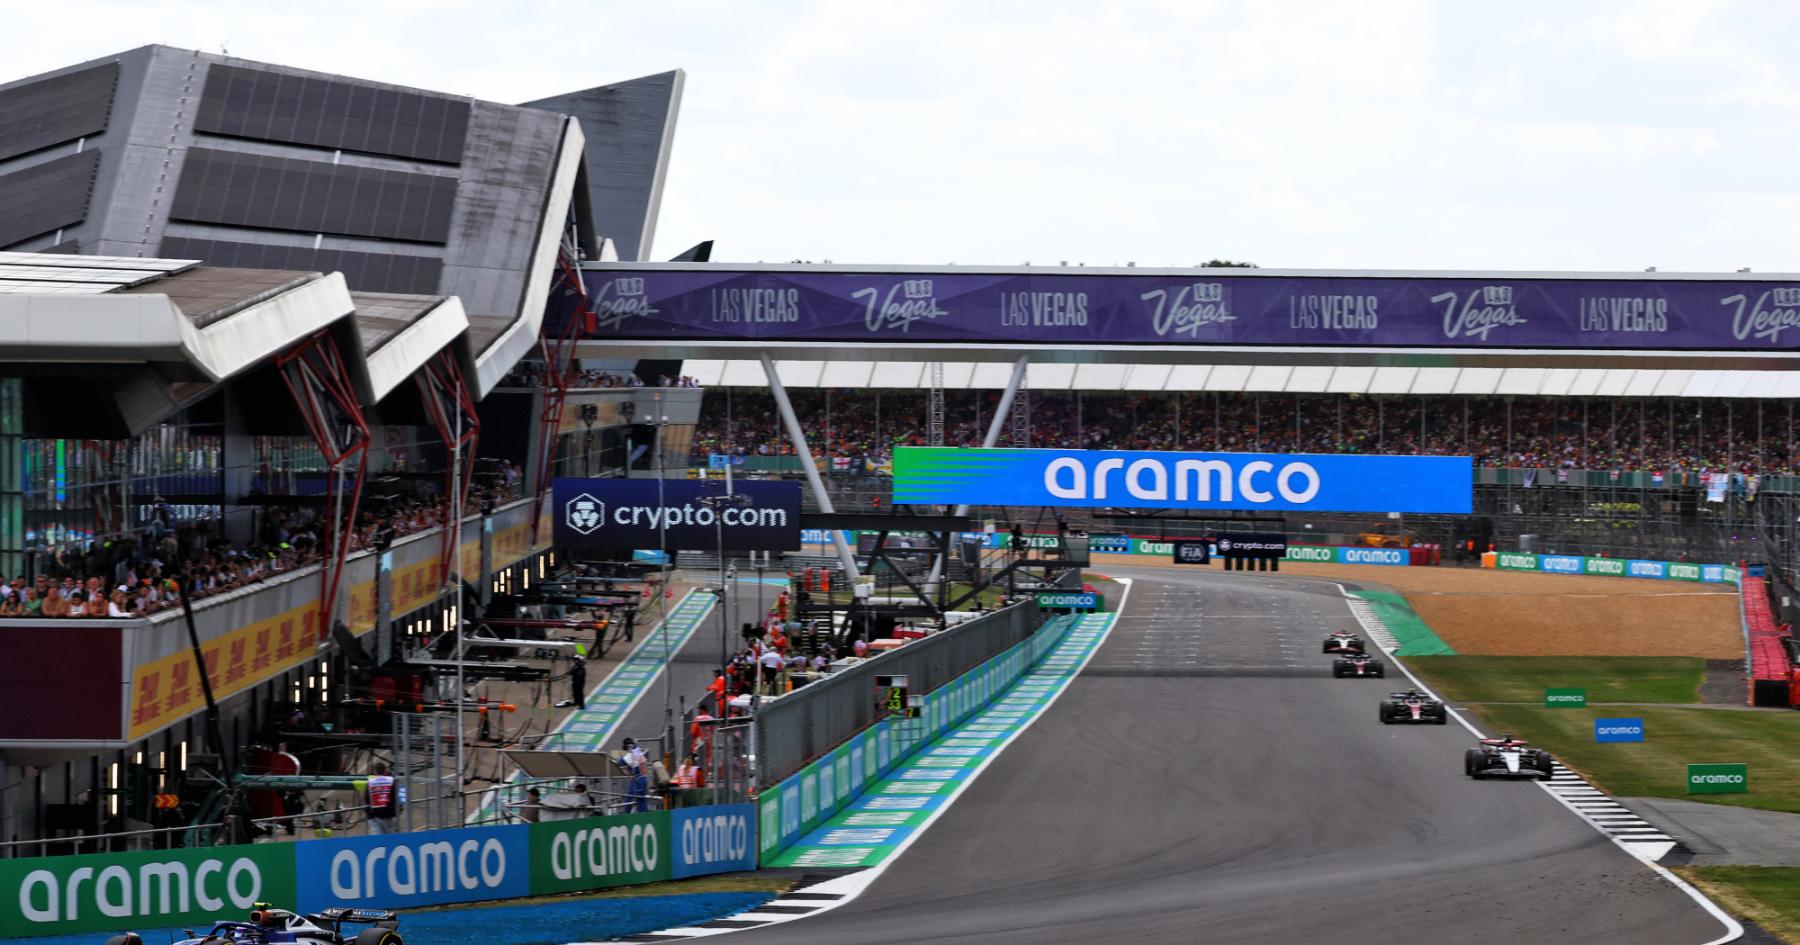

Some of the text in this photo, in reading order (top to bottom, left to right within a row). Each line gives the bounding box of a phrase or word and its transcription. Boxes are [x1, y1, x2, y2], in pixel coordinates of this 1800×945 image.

[711, 288, 799, 322] LAS VEGAS
[851, 283, 950, 333] Vegas
[1001, 292, 1088, 326] LAS VEGAS
[1141, 286, 1239, 338] Vegas
[1290, 295, 1378, 329] LAS VEGAS
[1431, 289, 1529, 341] Vegas
[1580, 297, 1668, 332] LAS VEGAS
[1720, 291, 1800, 343] Vega
[1044, 457, 1320, 503] aramco
[1232, 542, 1286, 551] crypto.com
[1286, 547, 1331, 560] ramco
[1346, 550, 1401, 563] aramco
[1040, 595, 1094, 605] aramco
[1598, 726, 1640, 734] aramco
[1691, 774, 1743, 783] aramco
[551, 823, 658, 880] aramco
[683, 814, 747, 865] aramco
[330, 838, 506, 900] aramco
[19, 857, 261, 922] aramco
